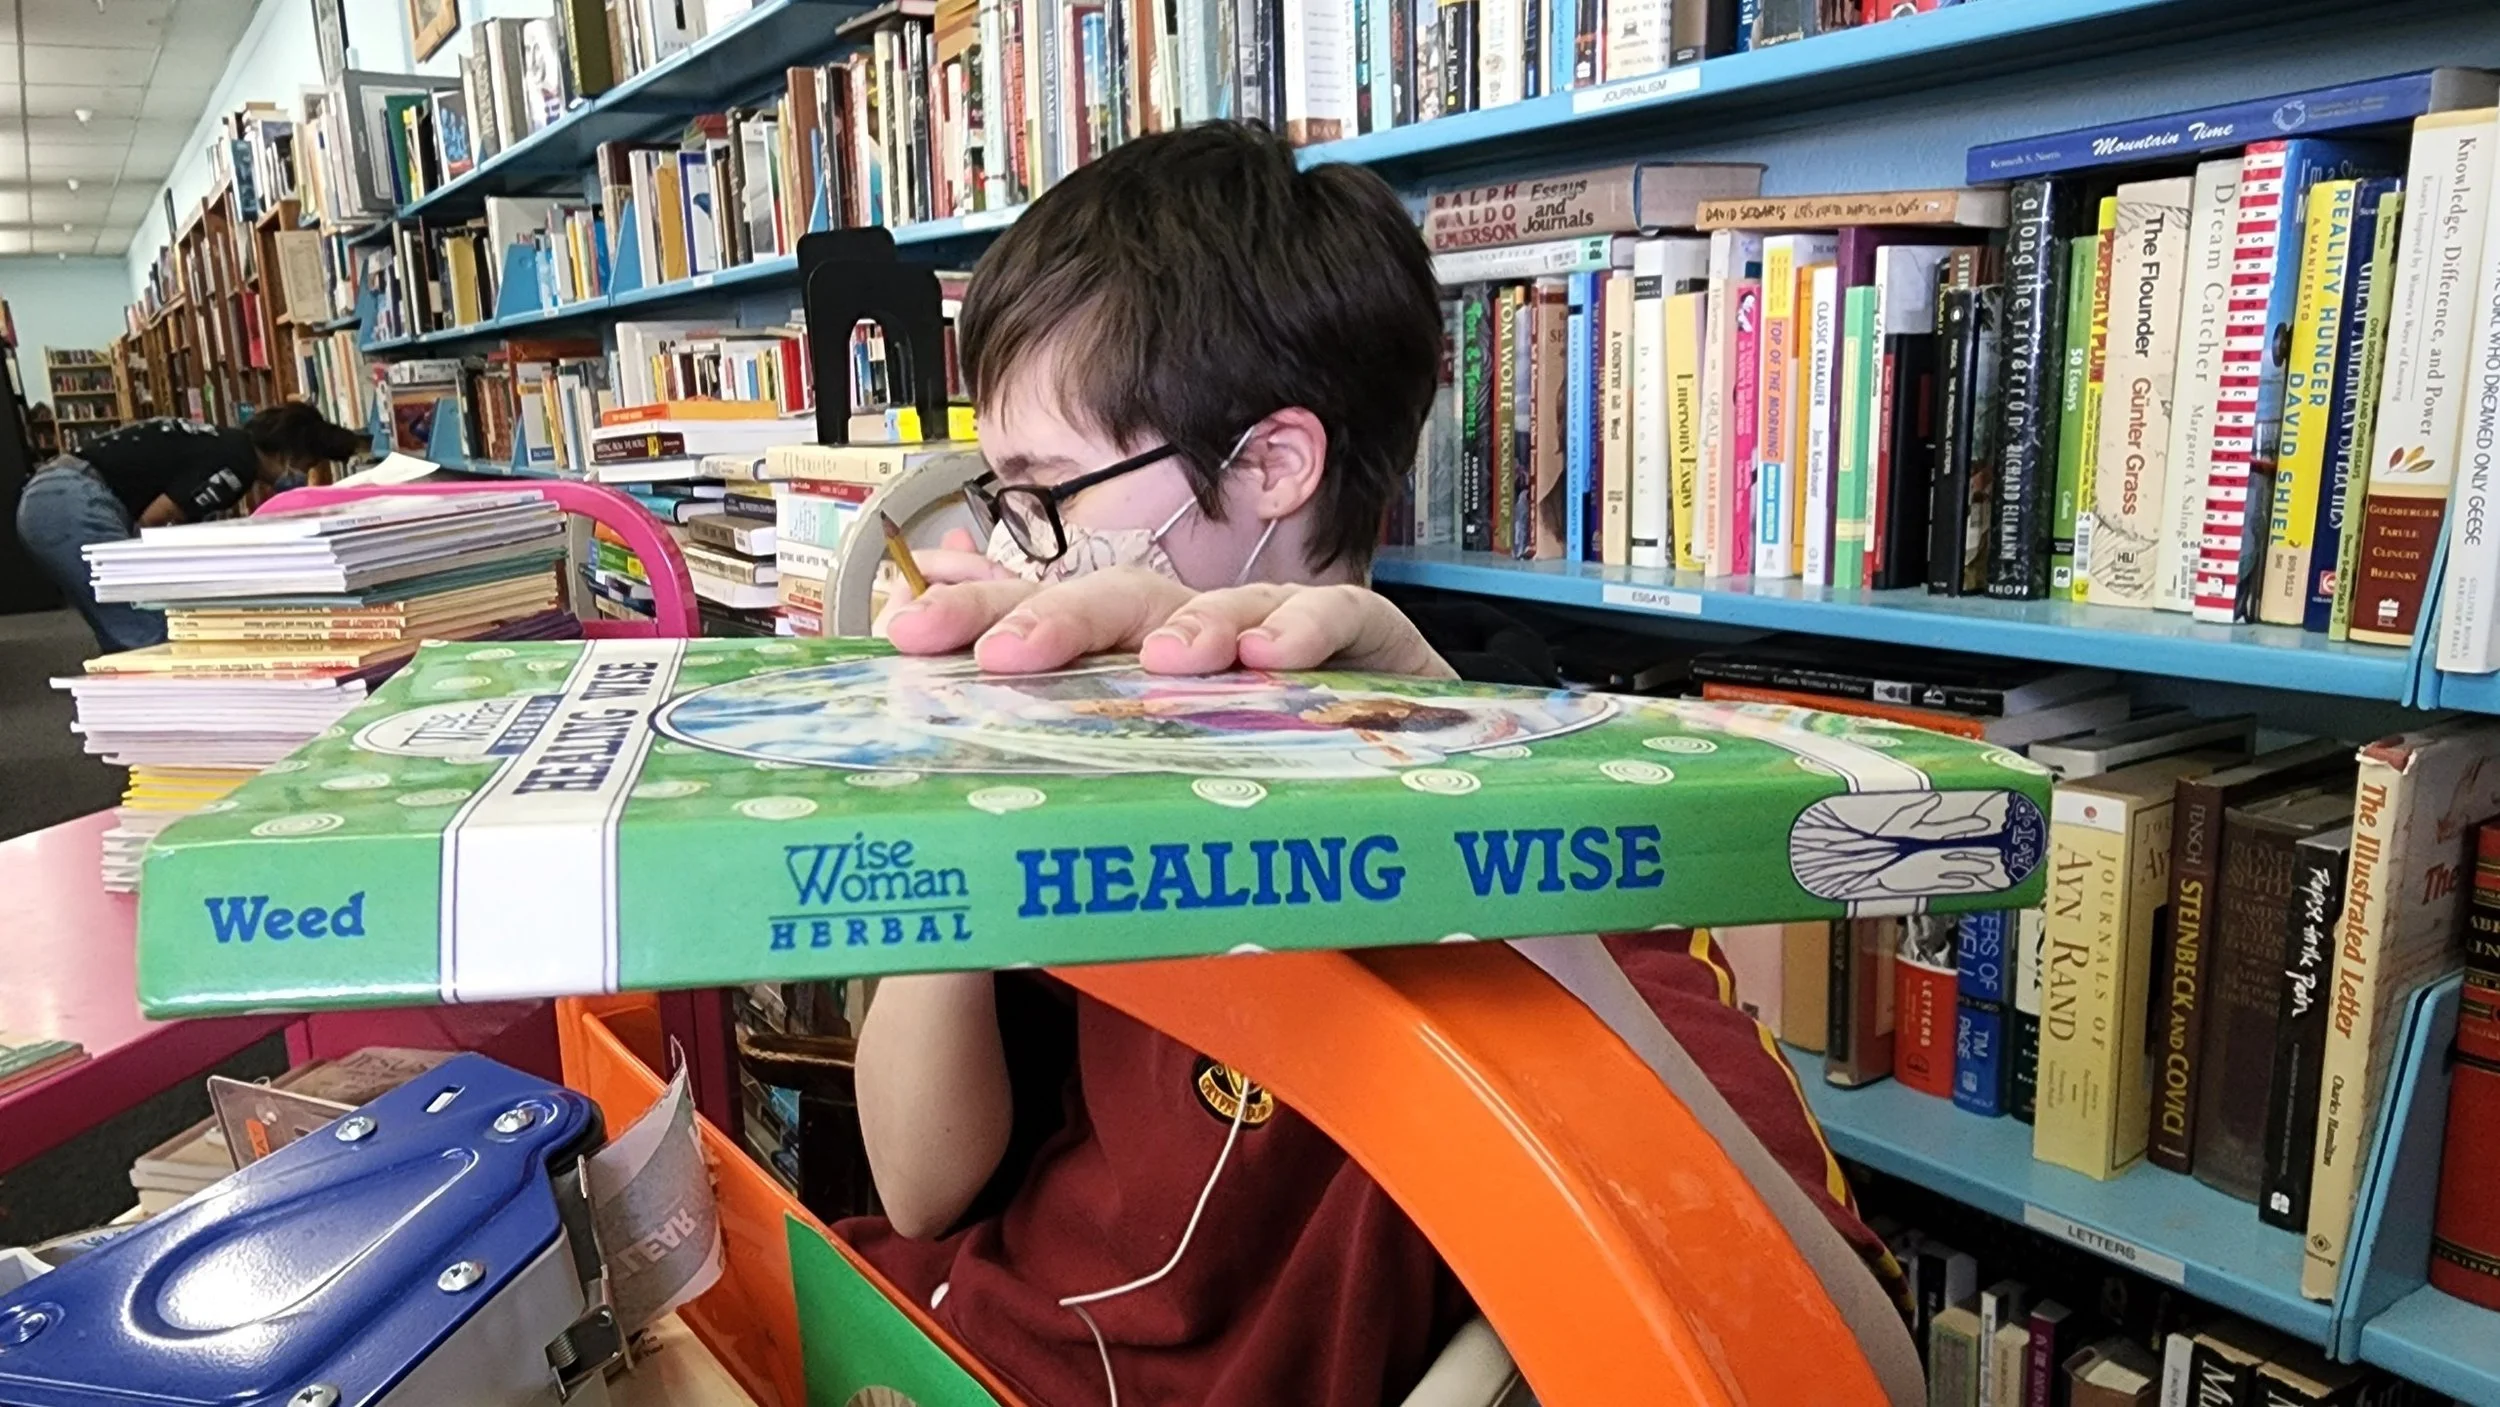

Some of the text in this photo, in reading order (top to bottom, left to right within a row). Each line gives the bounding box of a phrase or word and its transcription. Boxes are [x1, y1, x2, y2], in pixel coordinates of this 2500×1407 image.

[1045, 29, 1055, 133] HENRY JAMES
[1603, 79, 1667, 103] JOURNALISM
[1991, 156, 2024, 169] Kenneth
[2092, 122, 2234, 157] Mountain Time
[1434, 183, 1518, 210] RALPH
[1530, 179, 1588, 201] Essays
[1534, 198, 1567, 218] and
[1705, 205, 1737, 222] DAVID
[2022, 198, 2038, 211] a
[1433, 204, 1517, 229] WALDO
[1434, 223, 1518, 249] EMERSON
[1523, 210, 1594, 234] Journals
[2195, 184, 2236, 383] Dream Catcher
[2300, 234, 2318, 321] MANIFESTO
[2309, 189, 2352, 407] REALITY HUNGER
[2420, 137, 2477, 437] Knowledge, Difference, and Power
[1769, 320, 1783, 345] TOP
[1611, 342, 1621, 389] COUNTRY
[1768, 370, 1782, 391] THE
[1769, 350, 1782, 366] OF
[2067, 348, 2083, 411] 50 Essays
[2122, 212, 2165, 516] The Flounder Günter Grass
[1500, 295, 1513, 517] TOM WOLFE HOOKING UP
[1811, 301, 1828, 499] CLASSIC KRAKAUER Jon Krakauer
[2352, 317, 2379, 480] CIVIL DISOBEDIENCE AND OTHER ESSAYS
[1676, 374, 1696, 509] Emerson's Essays
[1766, 396, 1781, 457] MORNING
[2185, 404, 2205, 470] Margaret
[2464, 330, 2500, 546] WHO DREAMED ONLY GEESE
[2003, 444, 2023, 500] RICHARD
[2269, 373, 2305, 546] DAVID SHIEL
[2175, 495, 2195, 542] Saling
[2369, 504, 2440, 518] GOLDBERGER
[2379, 526, 2419, 538] TARULE
[2370, 567, 2418, 581] BELENKY
[2372, 546, 2422, 560] CLINCHY
[1632, 591, 1670, 606] ESSAYS
[1988, 583, 2029, 596] KNOPF
[1773, 674, 1798, 686] Letters
[1839, 681, 1866, 694] France
[512, 661, 660, 795] HEALING WISE
[2187, 803, 2207, 866] FENSCH
[784, 831, 913, 905] Wise
[1017, 824, 1665, 918] HEALING WISE
[2056, 842, 2092, 922] AYN
[204, 890, 366, 943] Weed
[769, 913, 973, 950] HERBAL
[2333, 782, 2388, 1040] The Illustrated Letter
[2091, 849, 2117, 1051] JOURNALS OF
[1978, 963, 1998, 991] OF
[2047, 937, 2090, 1042] RAND
[1920, 979, 1933, 1047] LETTERS
[2162, 878, 2204, 1138] STEINBECK AND COVICI
[1958, 1016, 1972, 1060] PAGE
[1973, 1029, 1988, 1058] TIM
[2322, 1074, 2345, 1167] Charles Hamilton
[2067, 1223, 2136, 1261] LETTERS
